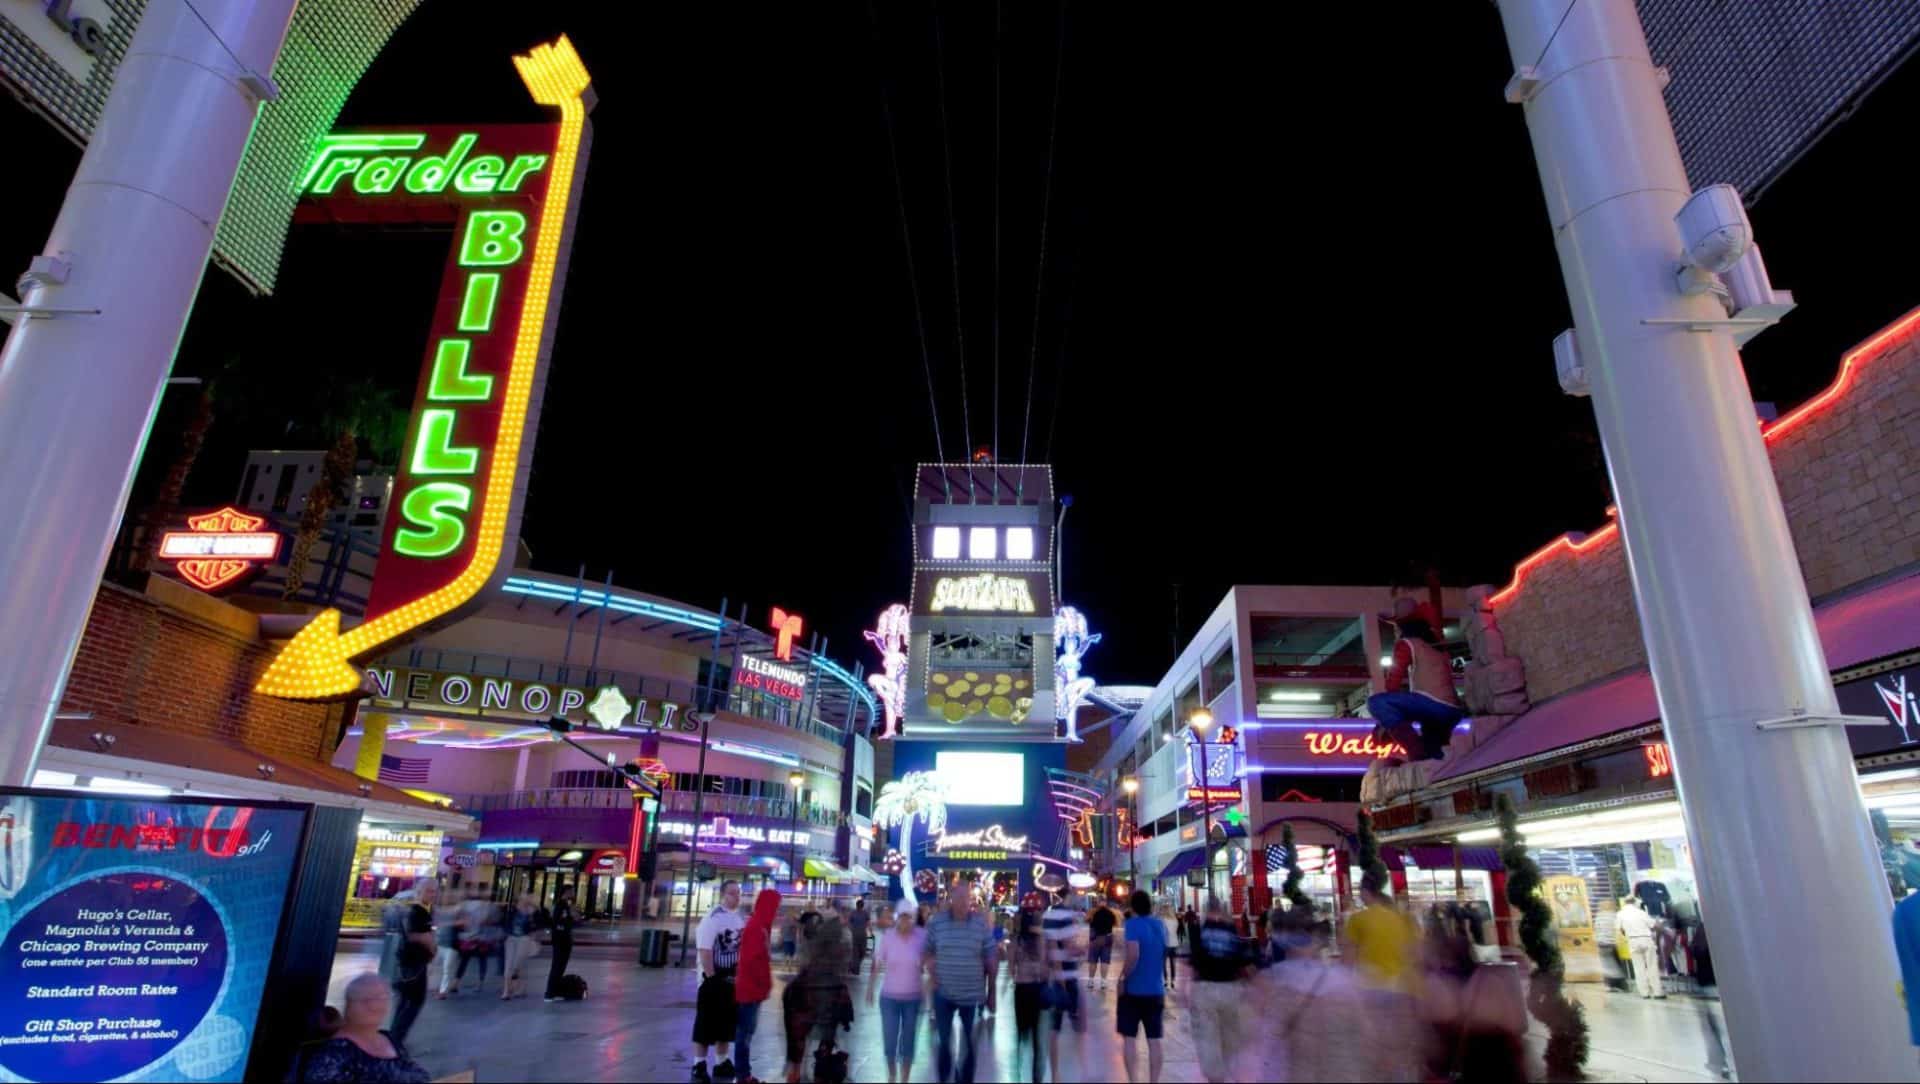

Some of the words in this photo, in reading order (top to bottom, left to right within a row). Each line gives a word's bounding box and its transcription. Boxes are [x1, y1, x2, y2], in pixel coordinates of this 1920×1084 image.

[298, 133, 548, 194] Trader
[393, 210, 527, 557] BILLS
[197, 511, 250, 532] MOTOR
[742, 655, 806, 687] TELEMUNDO
[737, 671, 761, 690] LAS
[765, 679, 804, 701] VEGAS
[367, 667, 705, 733] NEONOPLIS
[1188, 789, 1241, 803] Wagreens
[948, 851, 1008, 860] EXPERIENCE
[77, 909, 124, 921] Hugo's
[126, 910, 172, 922] Cellar,
[45, 925, 120, 938] Magnolia's
[124, 925, 181, 936] Veranda
[184, 924, 195, 936] &
[20, 941, 81, 954] Chicago
[84, 941, 141, 953] Brewing
[144, 940, 208, 953] Company
[22, 958, 48, 968] (one
[86, 958, 105, 967] per
[107, 957, 134, 966] Club
[151, 957, 199, 967] member)
[27, 985, 95, 998] Standard
[98, 985, 137, 997] Room
[140, 984, 178, 996] Rates
[26, 1019, 54, 1033] Gift
[56, 1019, 94, 1031] Shop
[97, 1017, 161, 1030] Purchase
[51, 1034, 76, 1044] food,
[140, 1030, 178, 1041] alcohol)
